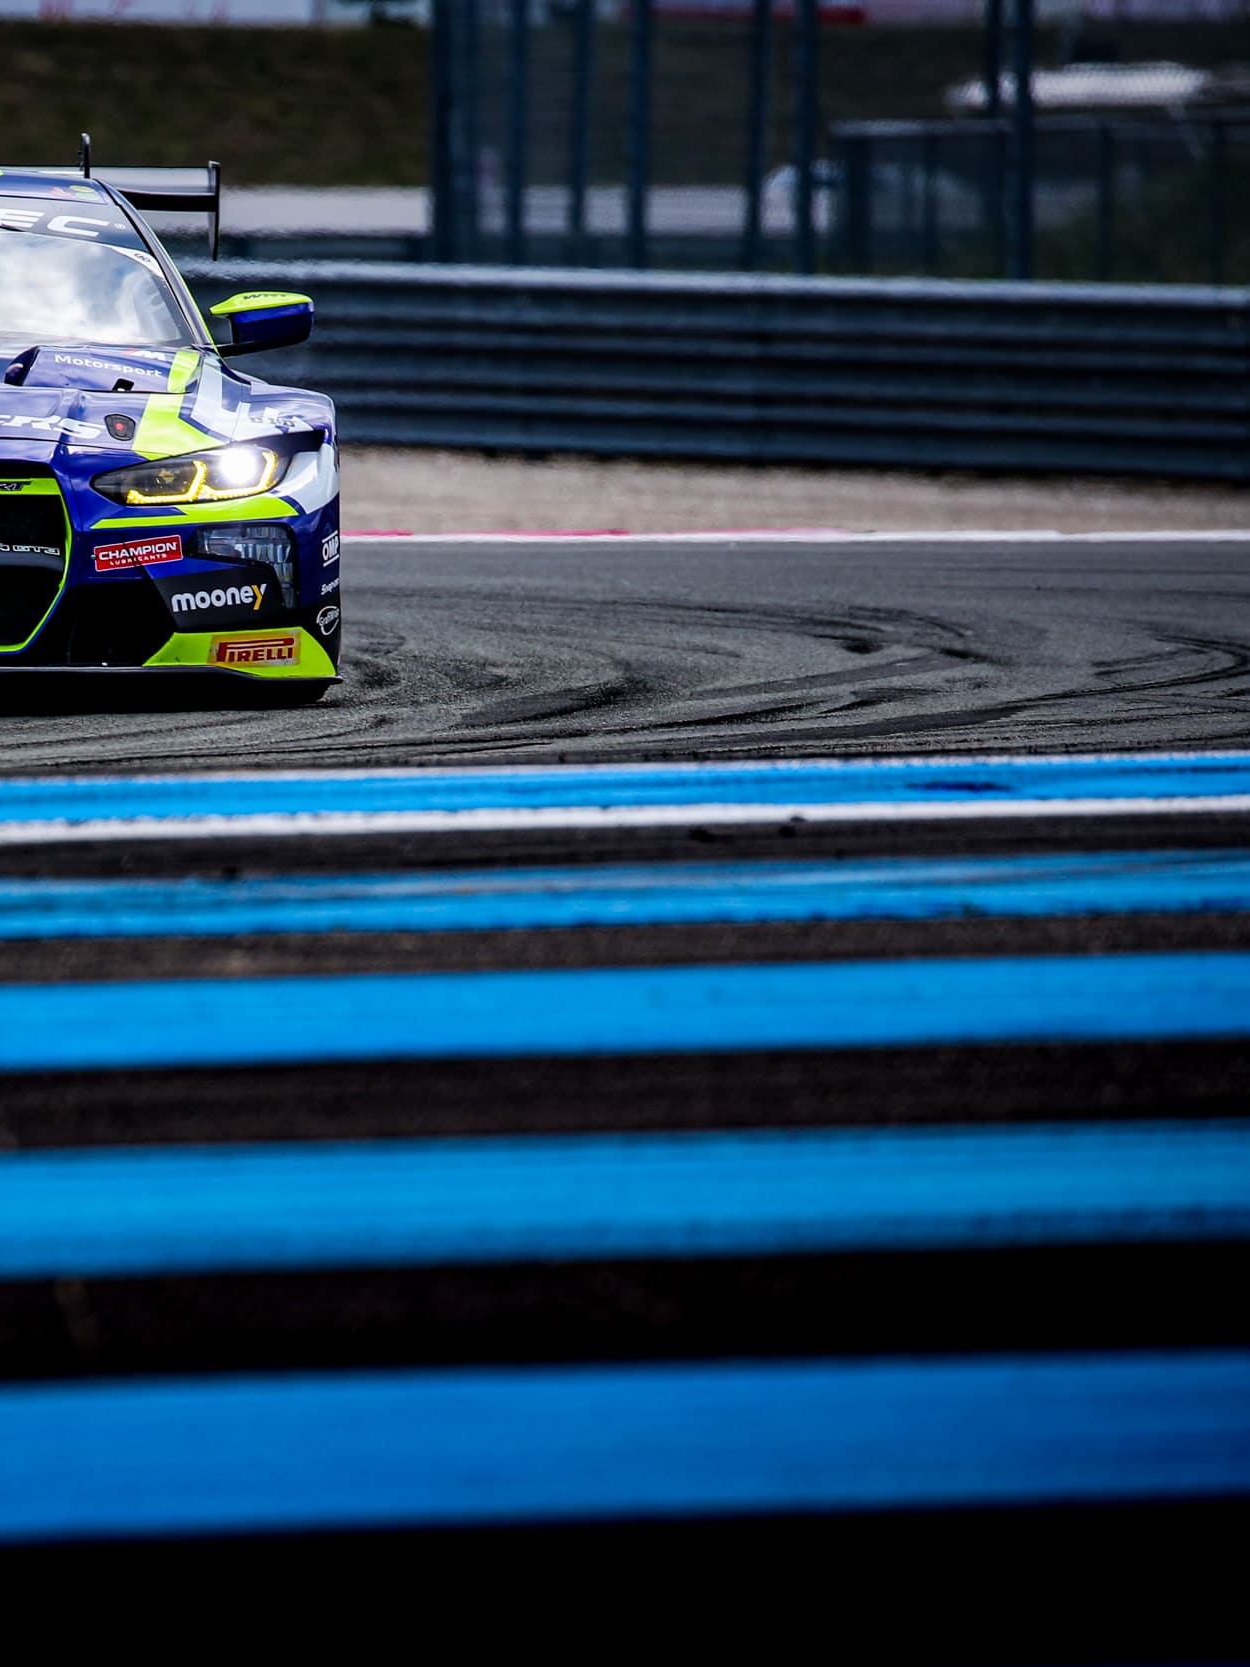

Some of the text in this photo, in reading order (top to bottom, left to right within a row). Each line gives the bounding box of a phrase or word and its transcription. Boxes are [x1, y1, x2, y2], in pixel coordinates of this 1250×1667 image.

[53, 354, 163, 378] Motorsport
[98, 541, 178, 561] CHAMPION
[110, 553, 168, 566] LUBRICANTS
[322, 535, 339, 561] OMP
[171, 582, 267, 613] mooney
[216, 637, 295, 663] PIRELLI
